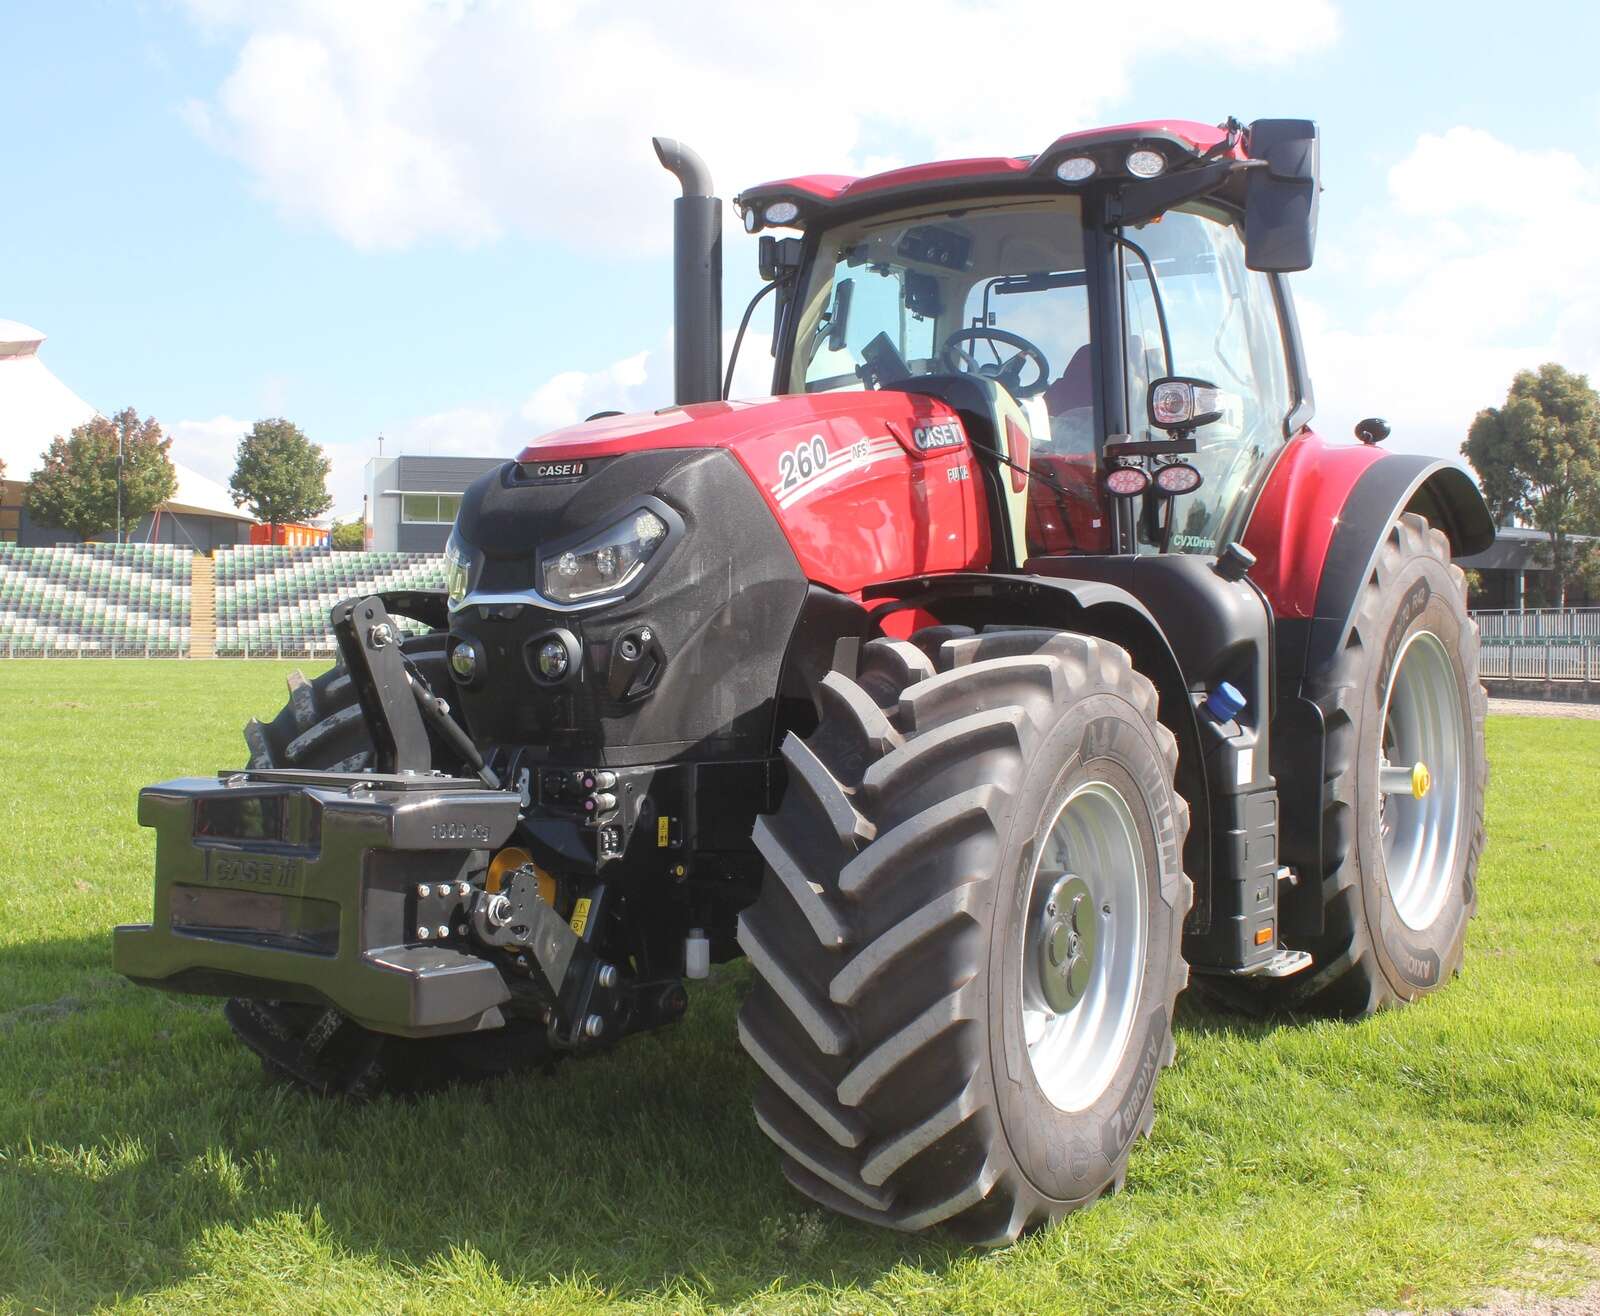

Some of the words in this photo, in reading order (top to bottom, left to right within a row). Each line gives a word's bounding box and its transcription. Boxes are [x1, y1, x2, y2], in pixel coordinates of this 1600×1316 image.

[914, 425, 953, 449] CASE
[851, 442, 869, 459] AFS
[538, 465, 571, 476] CASE
[780, 436, 828, 491] 260
[1173, 534, 1217, 549] CVXDrive
[216, 859, 273, 884] CASE
[1122, 1034, 1158, 1132] AXIOBIB
